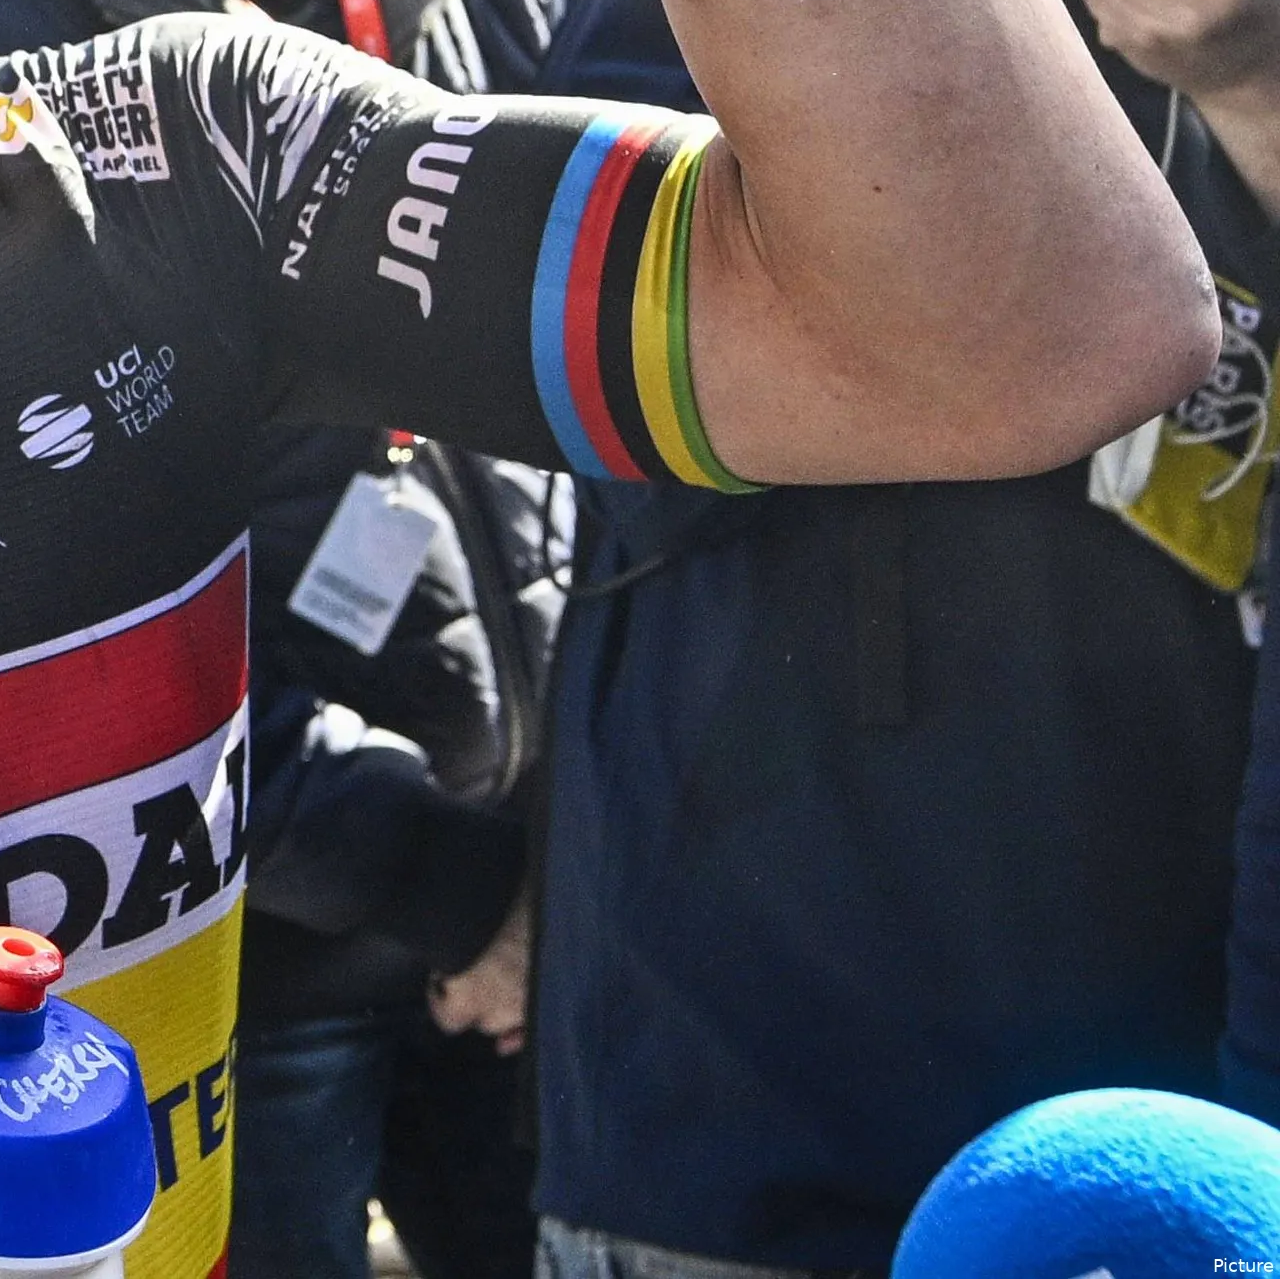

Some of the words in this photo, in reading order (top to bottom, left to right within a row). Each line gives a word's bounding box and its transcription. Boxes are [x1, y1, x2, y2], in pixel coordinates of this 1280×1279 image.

[57, 103, 157, 154] OGGER
[94, 342, 142, 389] UCI
[105, 345, 175, 413] WORLD
[116, 384, 174, 438] TEAM
